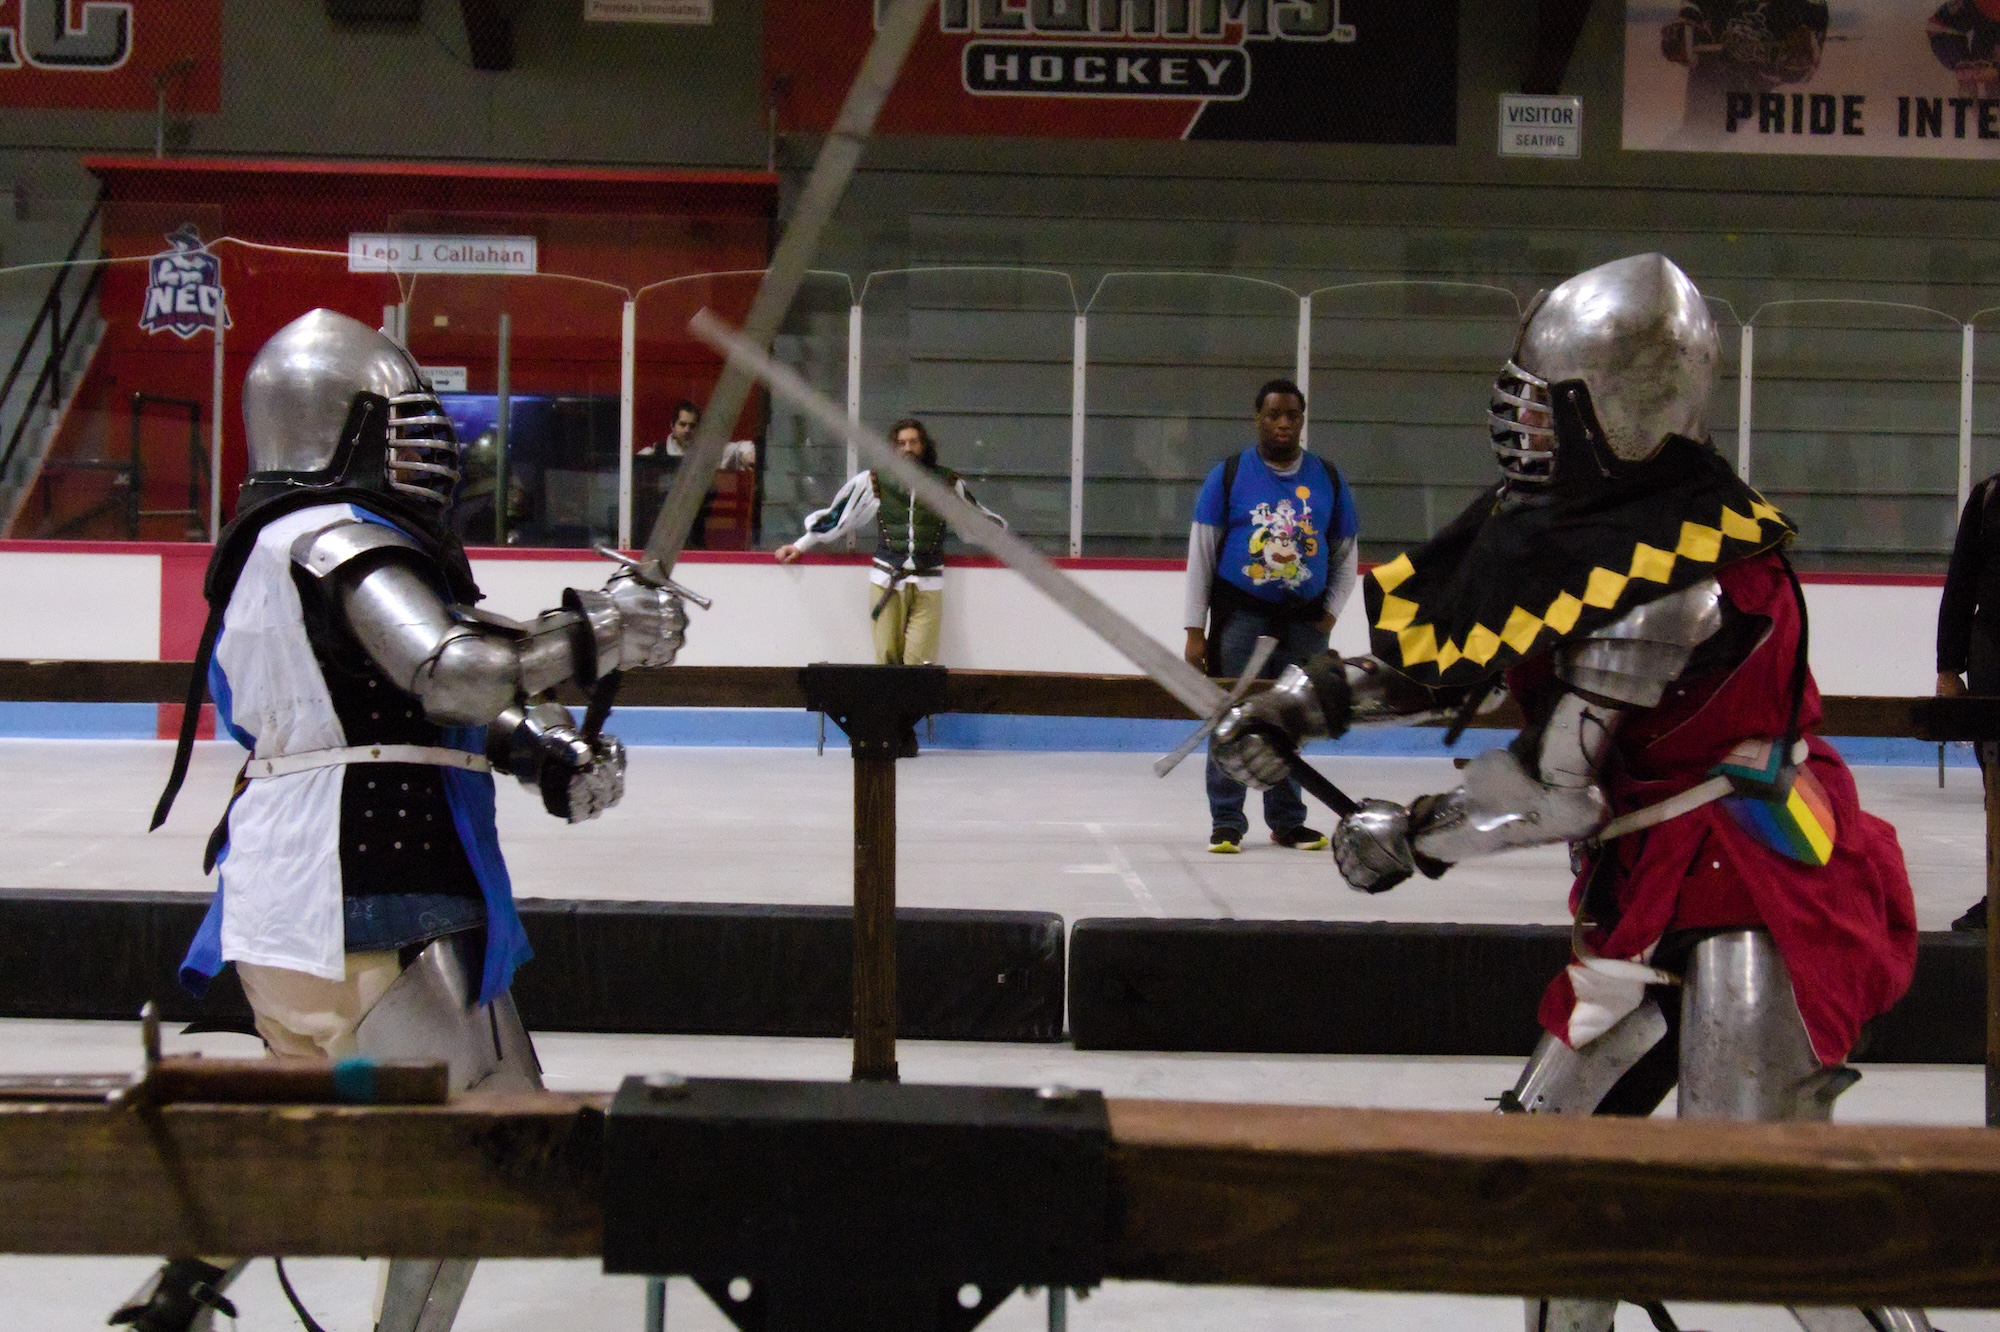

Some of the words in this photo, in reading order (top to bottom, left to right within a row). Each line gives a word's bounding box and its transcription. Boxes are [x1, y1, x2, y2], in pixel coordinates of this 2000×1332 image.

[983, 53, 1231, 86] HOCKEY
[1508, 106, 1574, 124] VISITOR
[1725, 91, 1866, 136] PRIDE
[1897, 96, 2000, 140] INTE
[1515, 134, 1565, 147] SEATING
[361, 243, 400, 262] Leo
[433, 244, 525, 263] Callahan
